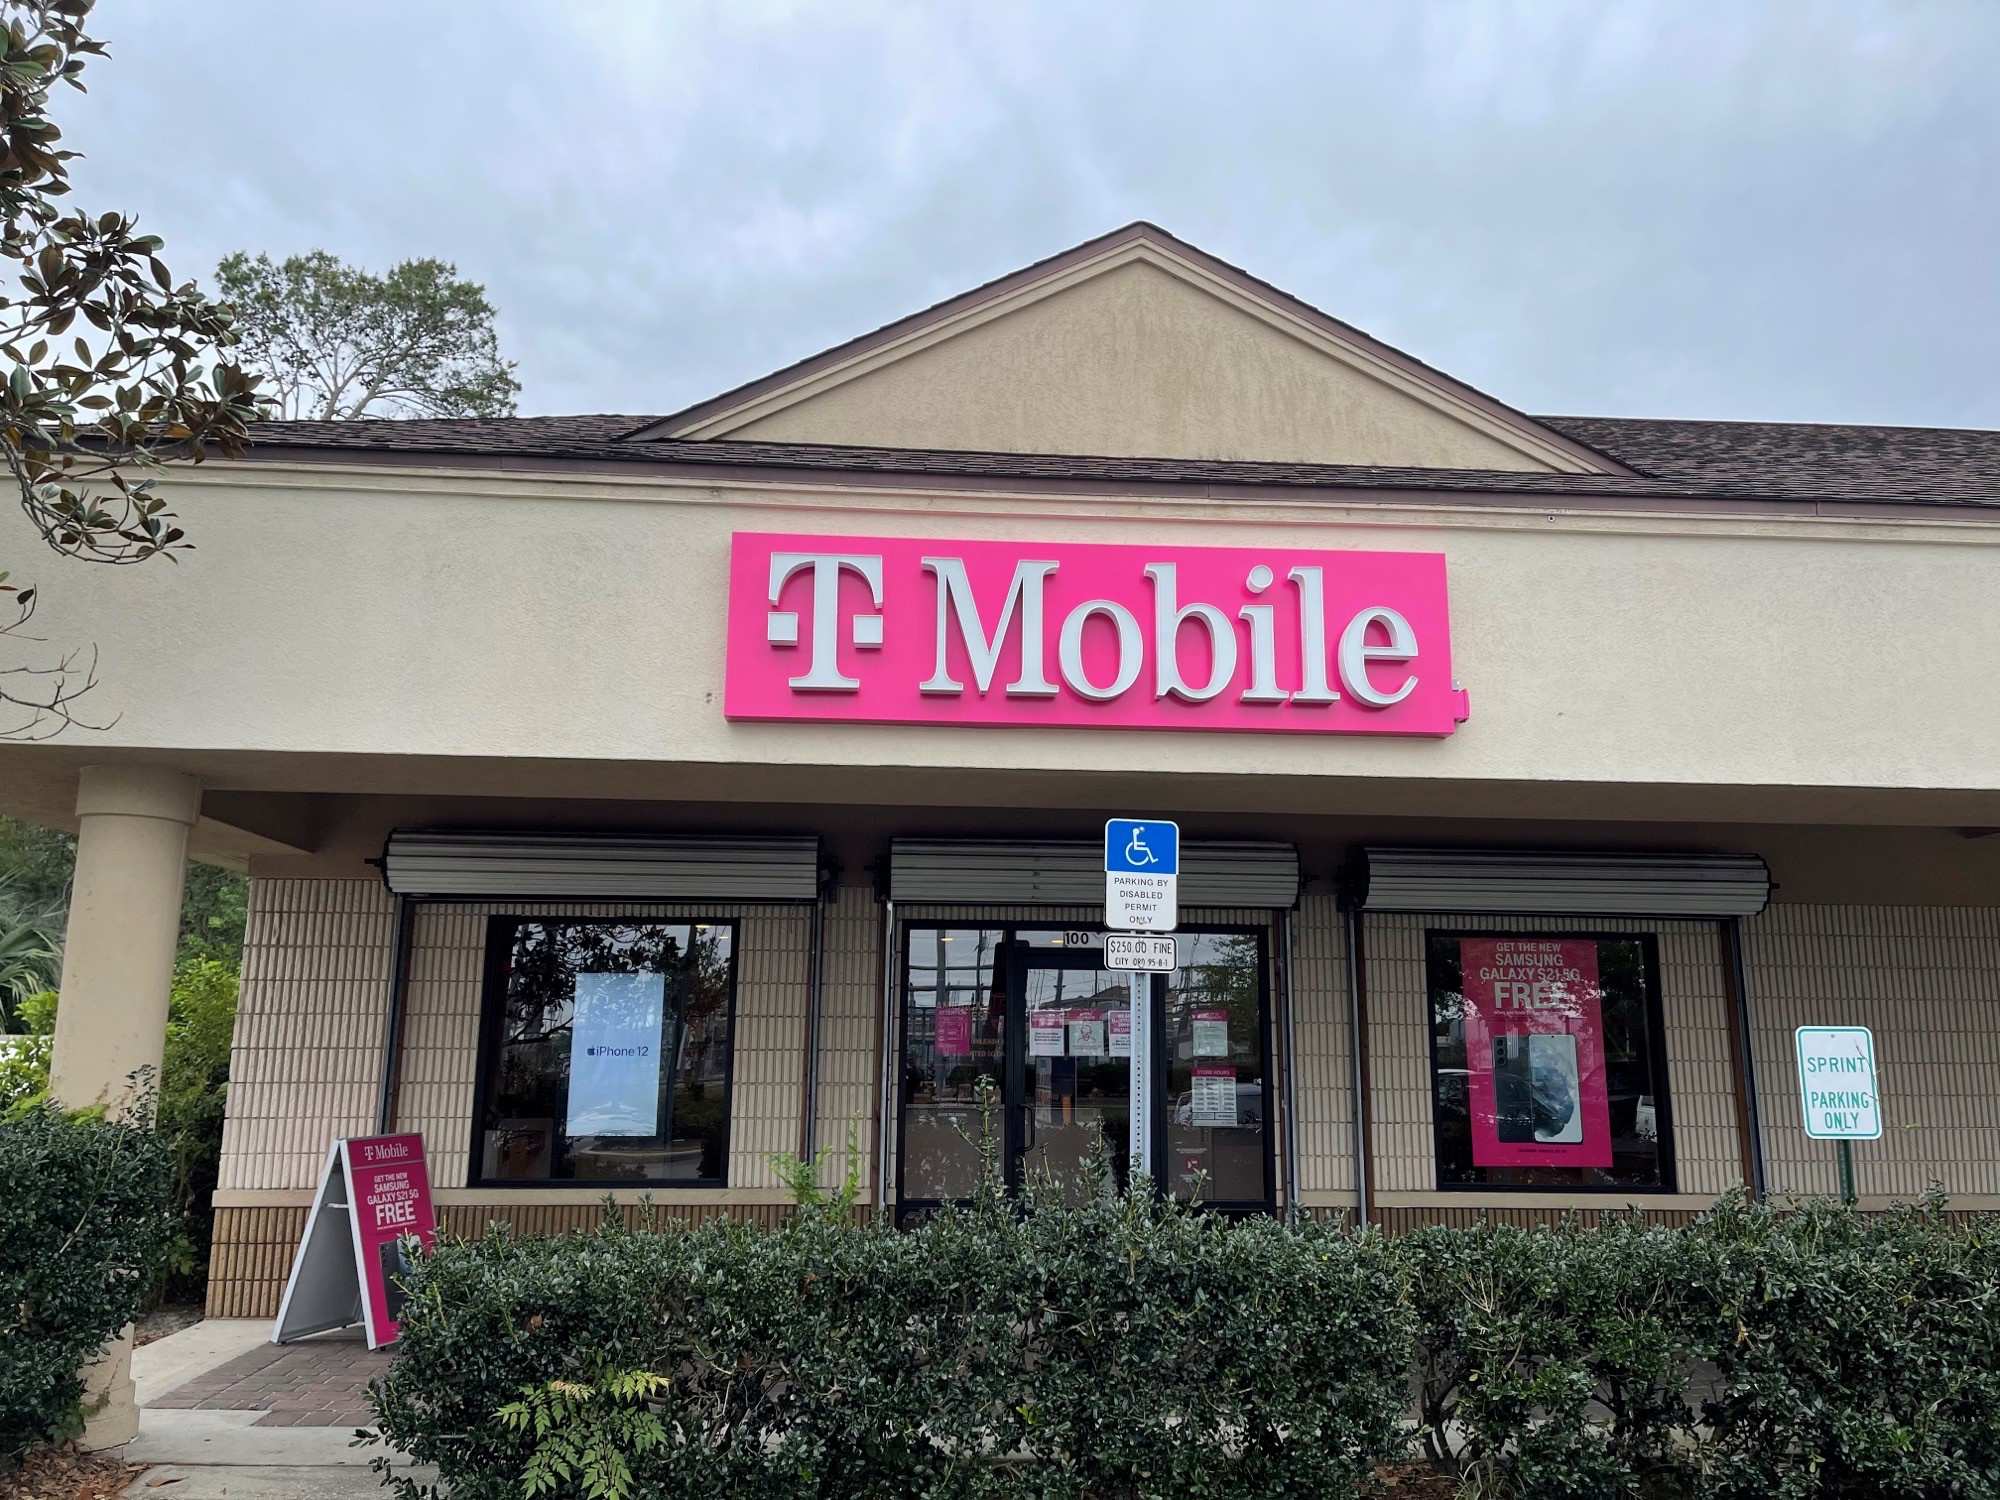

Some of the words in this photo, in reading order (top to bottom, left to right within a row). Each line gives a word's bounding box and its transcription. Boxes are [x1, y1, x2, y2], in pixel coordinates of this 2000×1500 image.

[766, 551, 884, 694] T
[918, 556, 1420, 710] Mobile
[1114, 877, 1153, 886] PARKING
[1157, 879, 1169, 887] BY
[1119, 890, 1163, 899] DISABLED
[1125, 903, 1157, 911] PERMIT
[1129, 915, 1153, 924] ONLY
[1065, 932, 1089, 945] 100
[1153, 942, 1172, 954] FINE
[1496, 942, 1516, 952] GET
[1518, 943, 1537, 953] THE
[1539, 943, 1561, 953] NEW
[1115, 957, 1129, 966] CITY
[1495, 953, 1564, 967] SAMSUNG
[1479, 967, 1534, 981] GALAXY
[1494, 982, 1569, 1009] FREE
[596, 1046, 635, 1057] iPhone
[637, 1046, 649, 1057] 12
[1807, 1056, 1866, 1073] SPRINT
[1811, 1091, 1870, 1109] PARKING
[1824, 1111, 1859, 1129] ONLY
[375, 1143, 409, 1160] Mobile
[374, 1174, 385, 1183] GET
[385, 1174, 396, 1182] THE
[396, 1172, 407, 1180] NEW
[374, 1180, 409, 1193] SAMSUNG
[367, 1191, 397, 1205] GALAXY
[397, 1190, 408, 1200] S21
[409, 1188, 419, 1199] 5G
[376, 1200, 417, 1226] FREE
